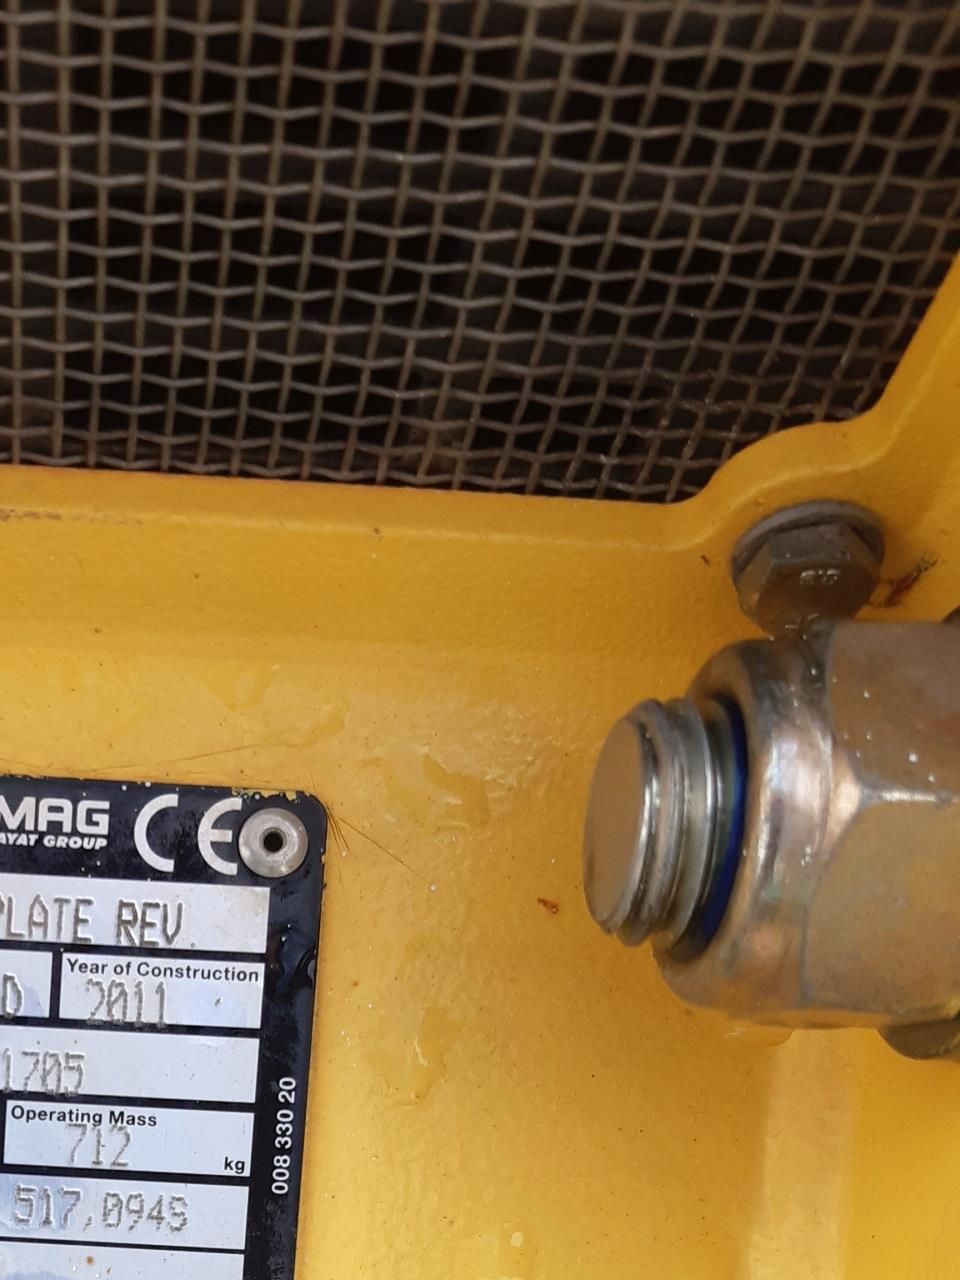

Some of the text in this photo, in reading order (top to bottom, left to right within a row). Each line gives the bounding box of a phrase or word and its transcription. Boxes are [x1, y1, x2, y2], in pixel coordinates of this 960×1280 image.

[42, 835, 108, 851] GROUP
[66, 958, 260, 983] Year of Construction
[1, 972, 24, 1018] D
[85, 977, 166, 1029] 2011
[3, 1047, 85, 1096] 1705
[10, 1104, 158, 1127] Operating Mass
[271, 1077, 296, 1195] 008 330 20
[65, 1122, 131, 1169] 712
[223, 1156, 246, 1173] kg
